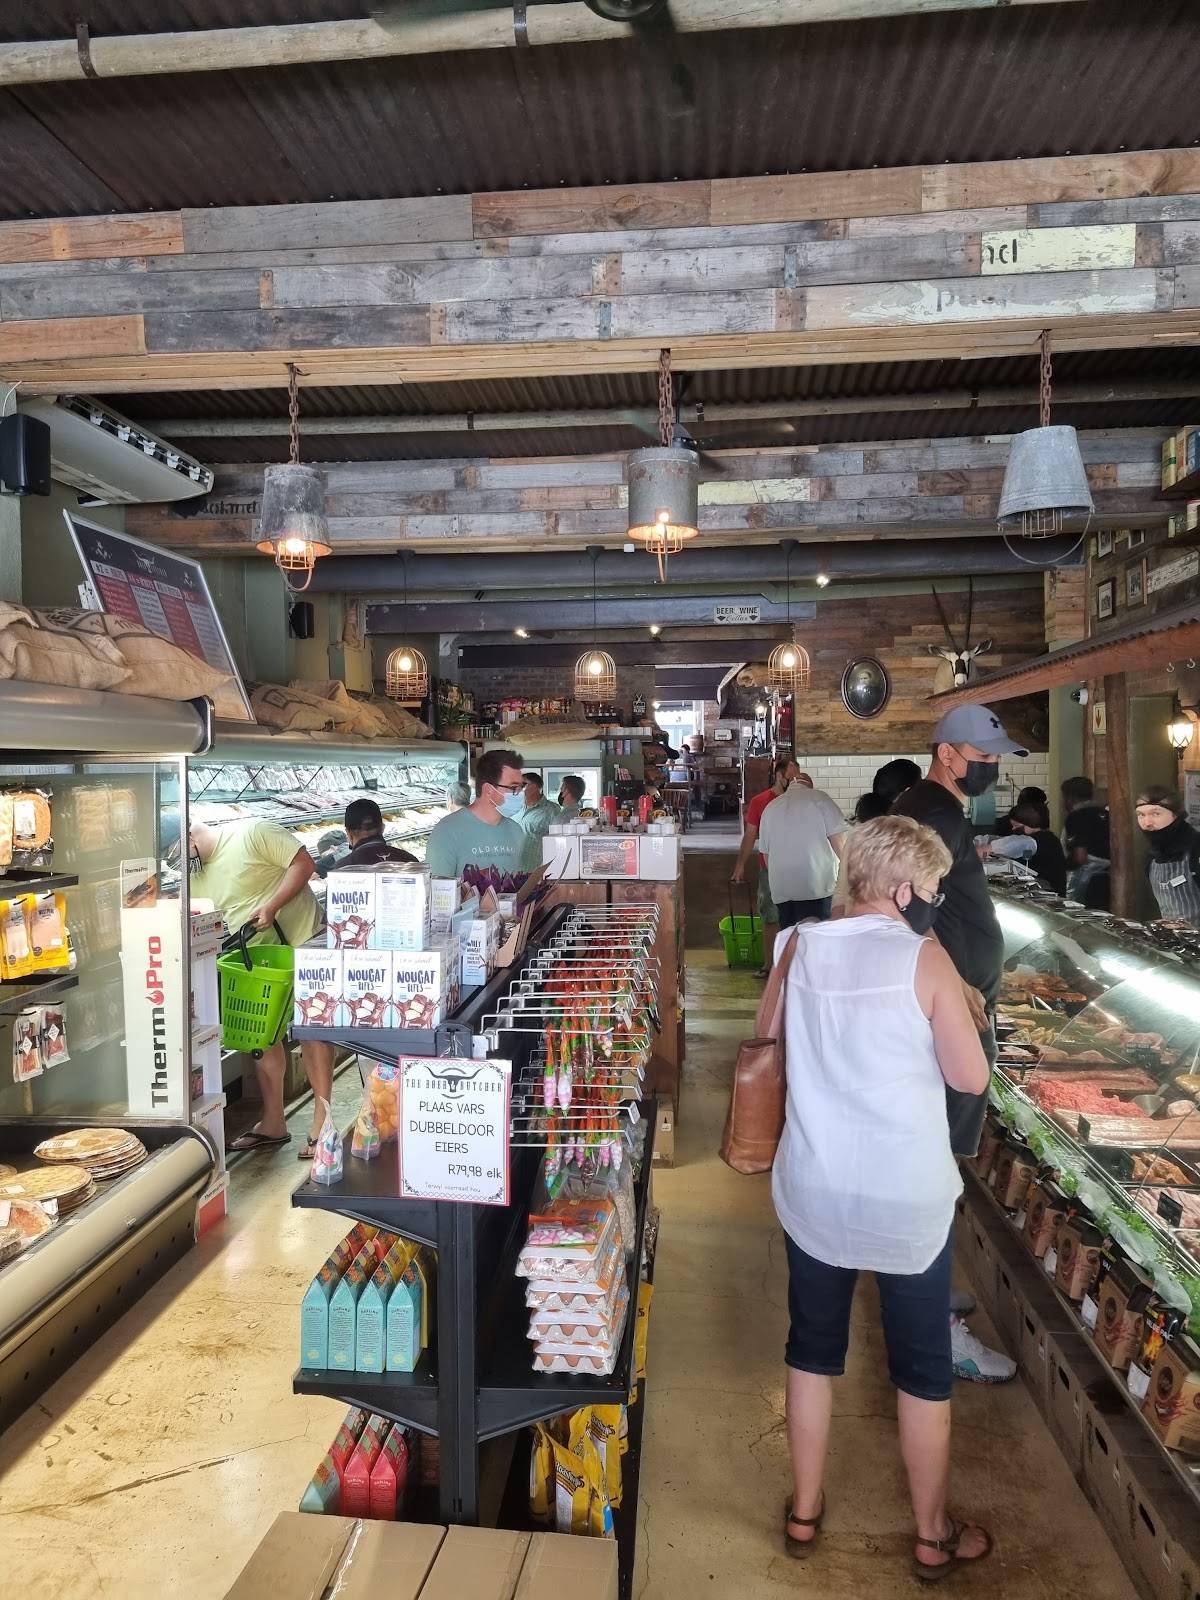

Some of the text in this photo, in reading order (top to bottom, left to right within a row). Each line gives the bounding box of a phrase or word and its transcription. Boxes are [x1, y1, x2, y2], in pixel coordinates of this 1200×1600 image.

[739, 606, 758, 614] WINE
[331, 890, 371, 905] NOUGAT
[342, 904, 359, 914] BITES
[298, 967, 337, 982] NOUGAT
[347, 968, 387, 983] NOUGAT
[396, 970, 437, 985] NOUGAT
[308, 981, 325, 990] BITES
[358, 982, 375, 991] BITES
[407, 983, 424, 993] BITES
[406, 1079, 421, 1089] THE
[426, 1080, 447, 1091] BOER
[460, 1080, 502, 1093] BUTCHER
[419, 1100, 485, 1115] PLAAS VARS
[409, 1120, 495, 1137] DUBBELDOOR
[435, 1141, 469, 1154] EIERS
[448, 1163, 502, 1179] R79,98 elk
